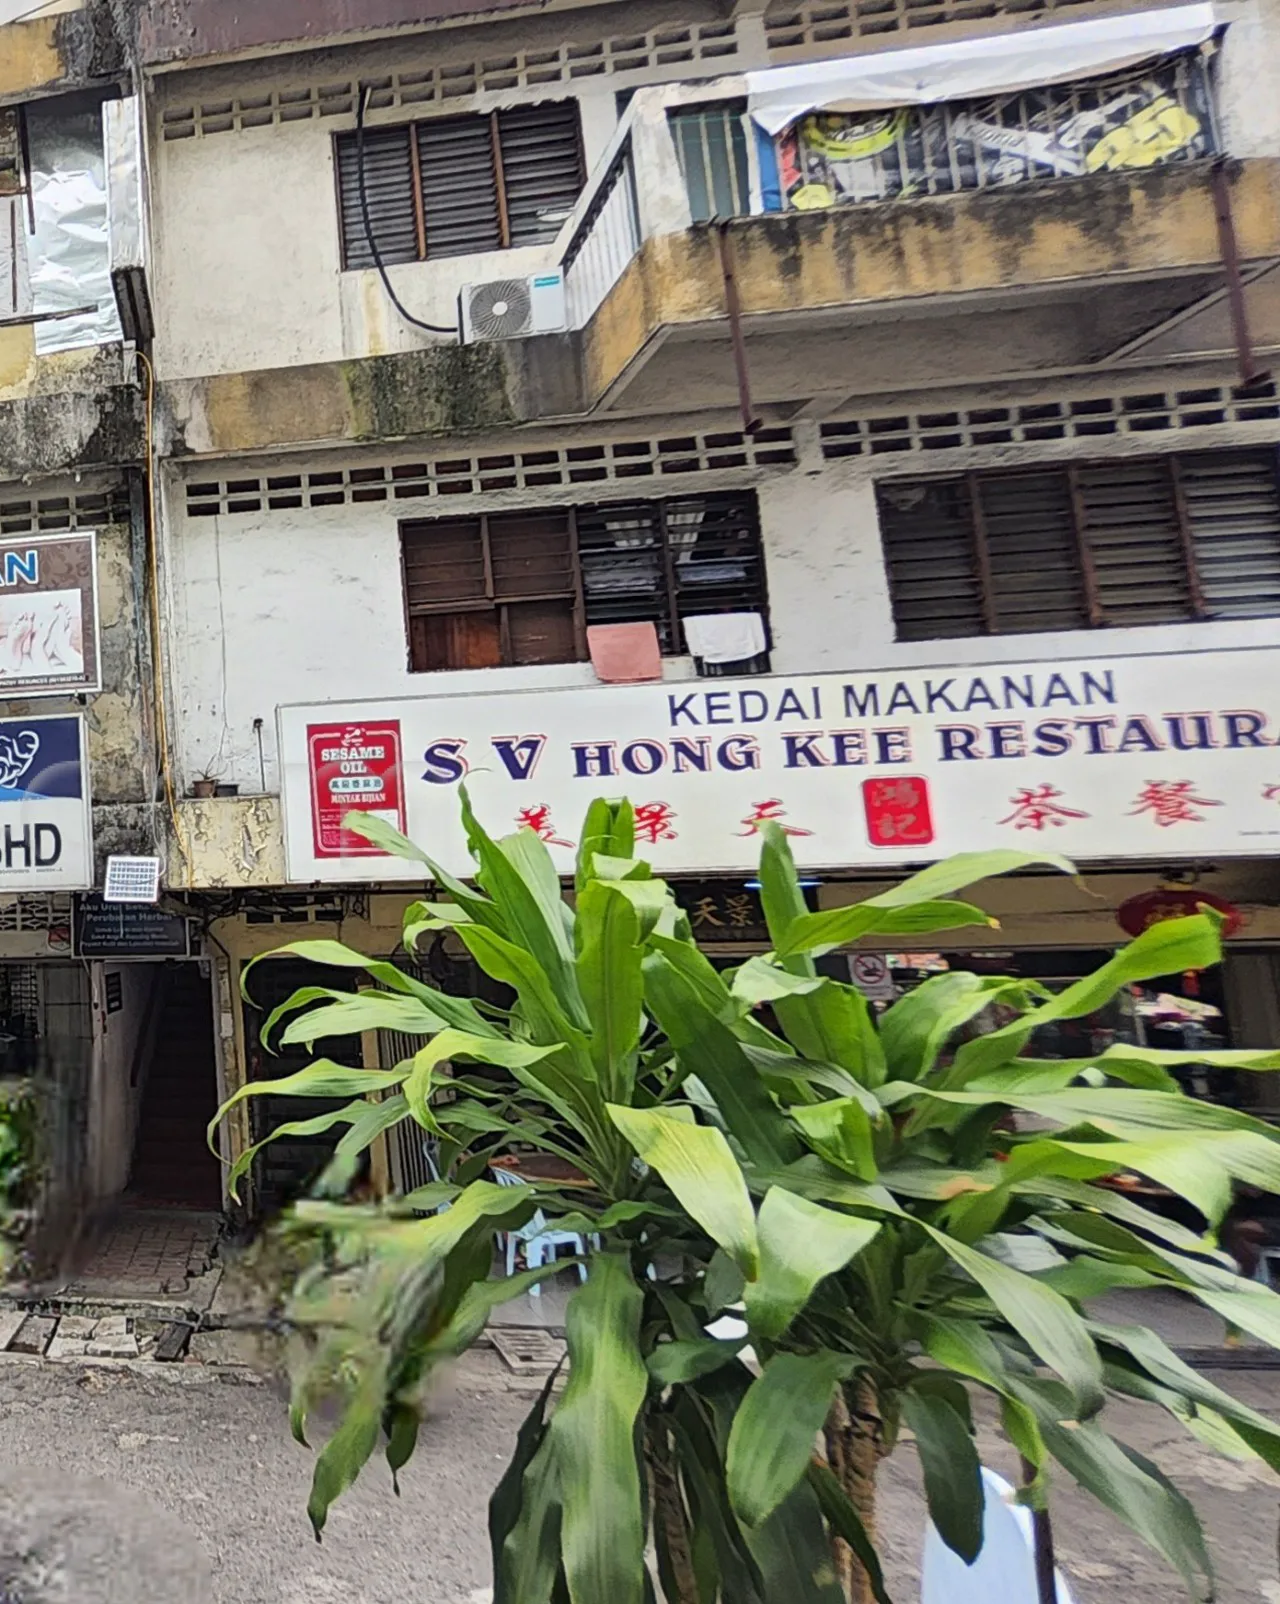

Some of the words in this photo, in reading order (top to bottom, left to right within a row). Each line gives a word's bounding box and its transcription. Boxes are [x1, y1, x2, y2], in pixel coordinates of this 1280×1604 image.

[667, 686, 822, 727] KEDAI
[842, 669, 1119, 718] MAKANAN
[321, 745, 385, 762] SESAME
[421, 738, 469, 785] S
[490, 733, 548, 781] V
[570, 734, 762, 778] HONG
[780, 725, 913, 770] KEE
[934, 708, 1280, 762] RESTAUR
[340, 761, 367, 774] OIL
